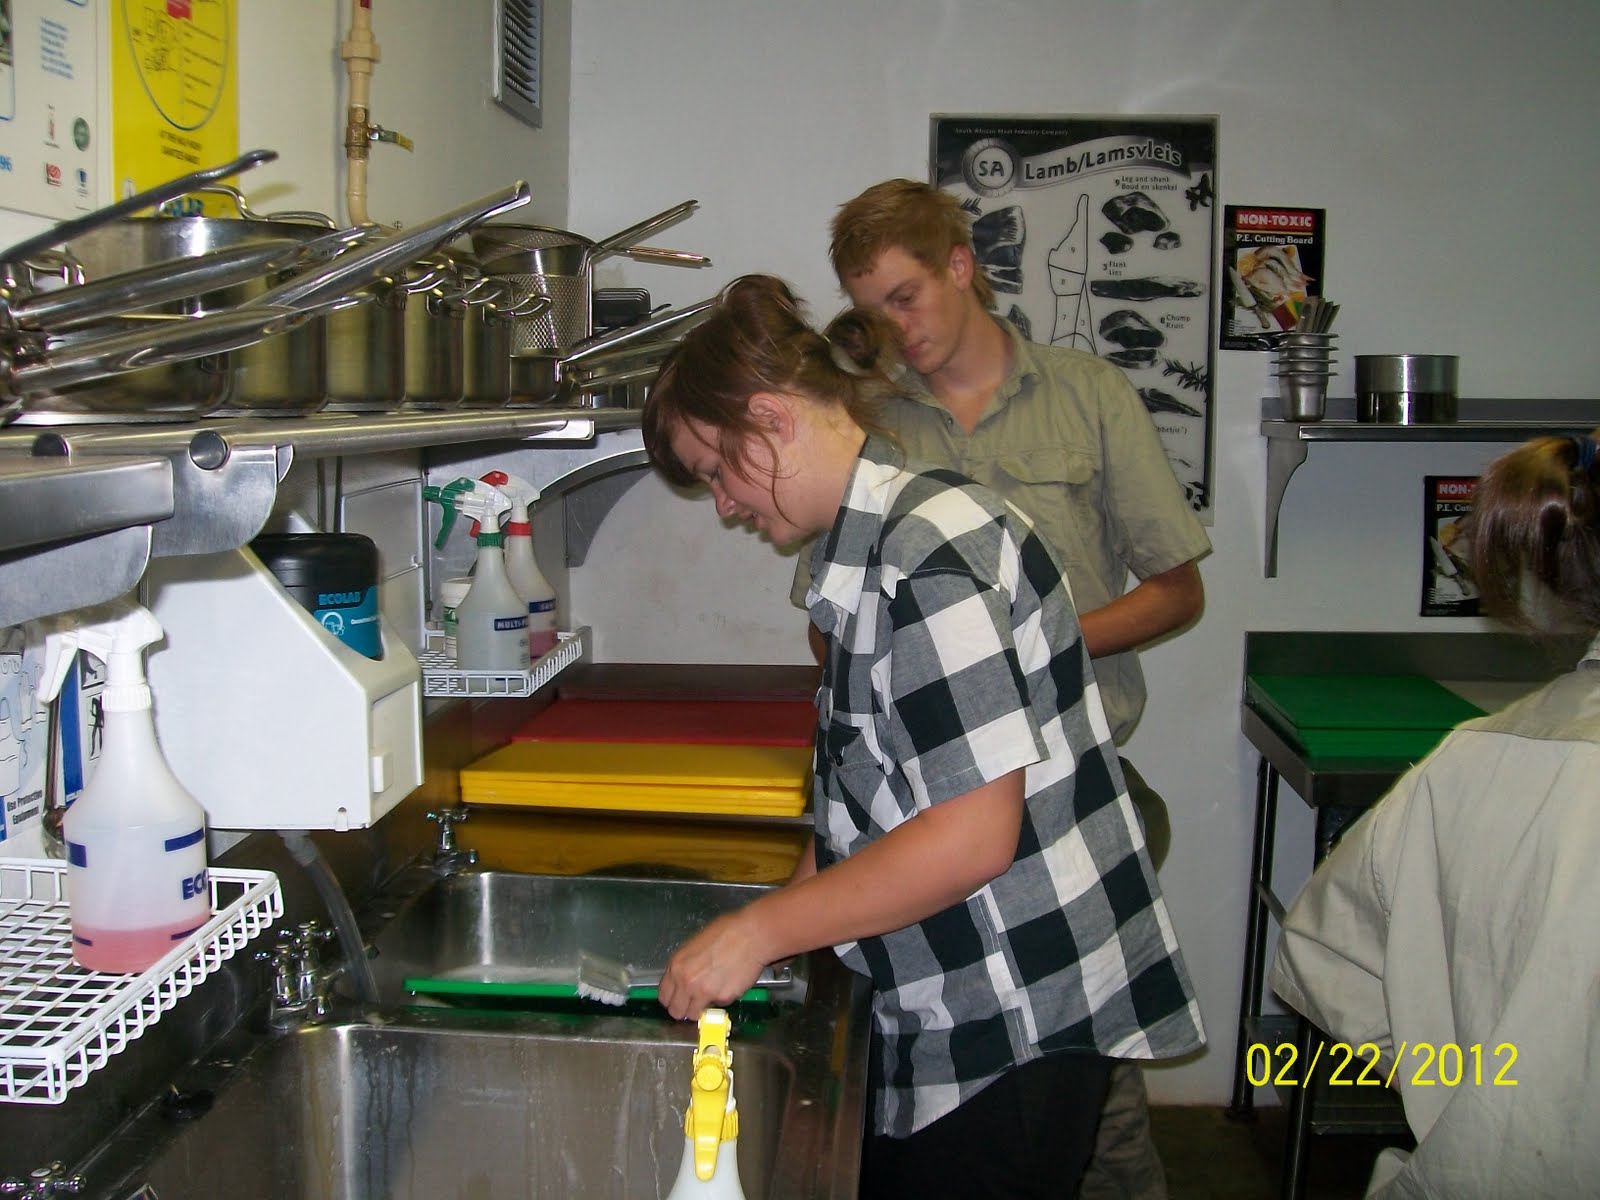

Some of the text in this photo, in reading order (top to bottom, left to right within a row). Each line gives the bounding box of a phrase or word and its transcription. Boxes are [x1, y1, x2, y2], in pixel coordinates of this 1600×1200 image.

[978, 160, 1004, 177] SA
[1121, 175, 1134, 183] Leg
[1239, 213, 1313, 227] NON-TOXIC
[1236, 233, 1314, 245] P.E. Cutting Board
[1166, 314, 1191, 323] Chump
[1436, 503, 1453, 512] P.E.
[318, 591, 361, 606] ECOLAB
[6, 800, 17, 812] Use
[12, 805, 40, 825] Equipment
